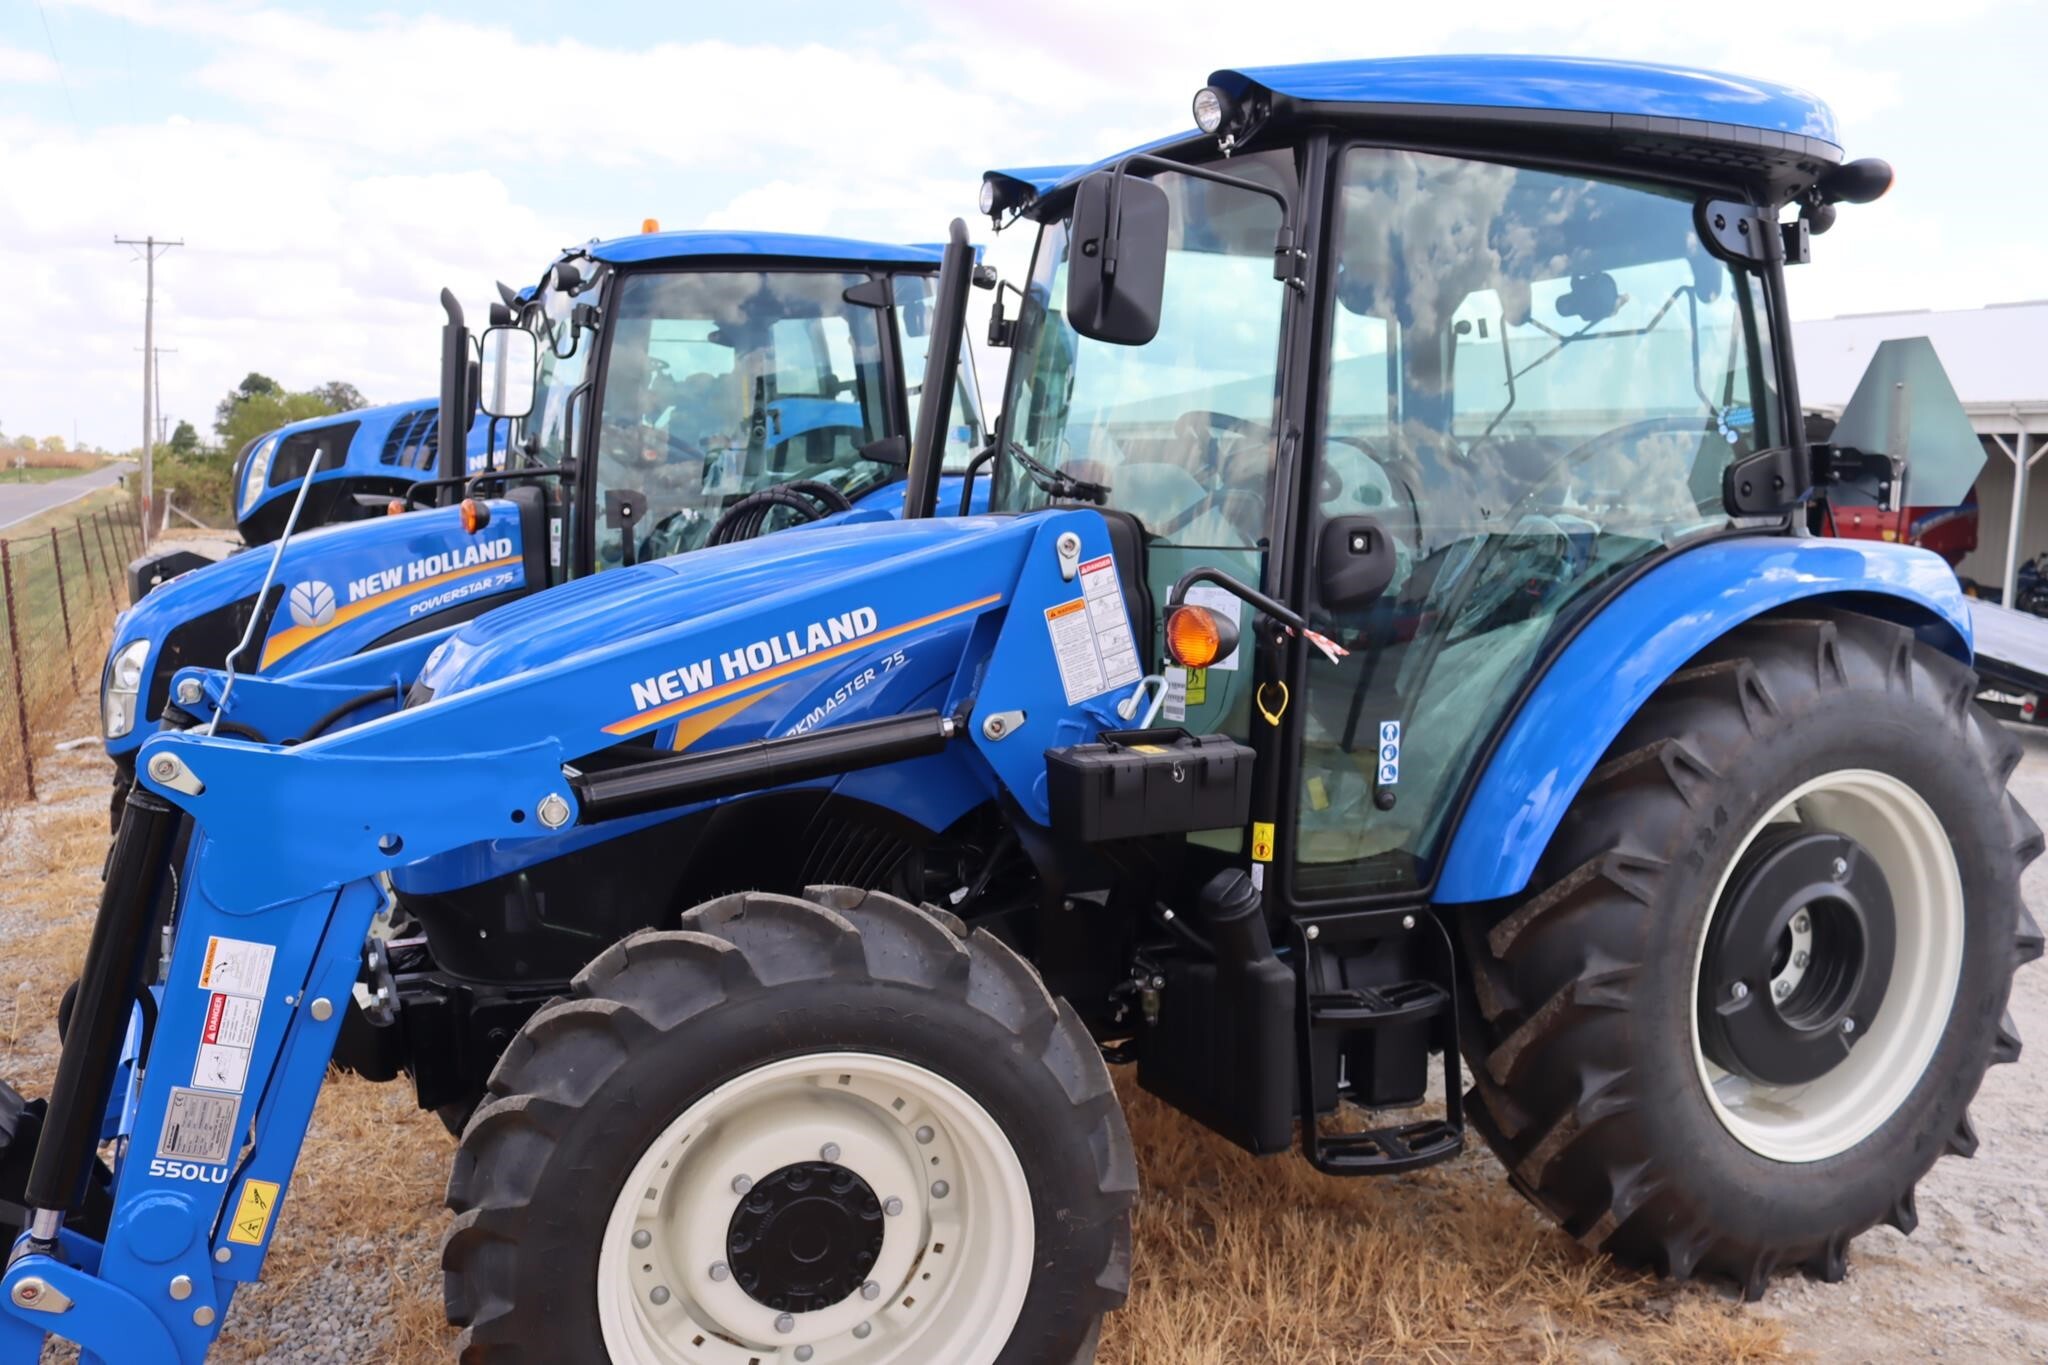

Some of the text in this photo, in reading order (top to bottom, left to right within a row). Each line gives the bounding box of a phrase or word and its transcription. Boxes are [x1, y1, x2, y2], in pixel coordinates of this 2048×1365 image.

[349, 565, 403, 602] NEW
[408, 538, 512, 582] HOLLAND
[410, 573, 514, 615] POWERSTAR 75
[629, 606, 878, 711] NEW HOLLAND
[786, 649, 906, 737] KMASTER 75
[205, 941, 218, 975] WARNING
[208, 995, 222, 1031] DANGER
[149, 1160, 228, 1183] 550LU
